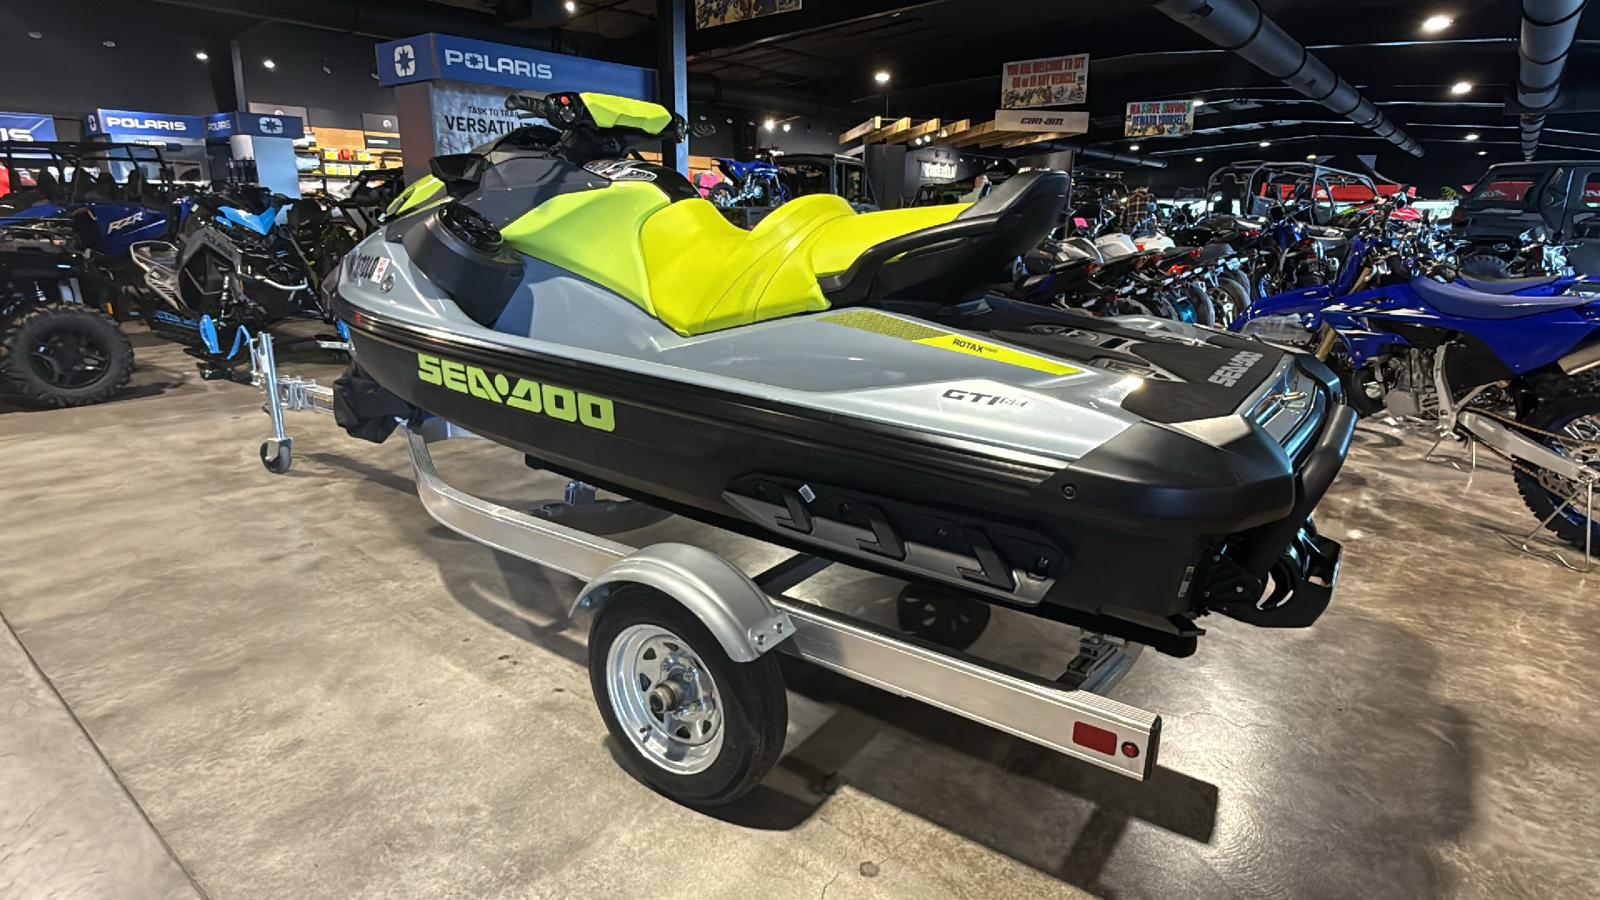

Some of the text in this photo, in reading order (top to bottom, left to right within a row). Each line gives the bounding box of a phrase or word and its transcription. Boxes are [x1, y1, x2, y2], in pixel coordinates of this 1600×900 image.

[444, 49, 553, 80] POLARIS
[1007, 57, 1086, 76] YOU ARE WELCOME TO SIT
[1051, 72, 1077, 85] VEHICLE
[468, 106, 488, 116] TASK
[489, 108, 499, 117] TO
[106, 116, 187, 131] POLARIS
[207, 120, 231, 131] POLARIS
[1158, 114, 1187, 125] YOURSELF
[107, 211, 144, 235] RZR
[952, 338, 984, 353] ROTAX
